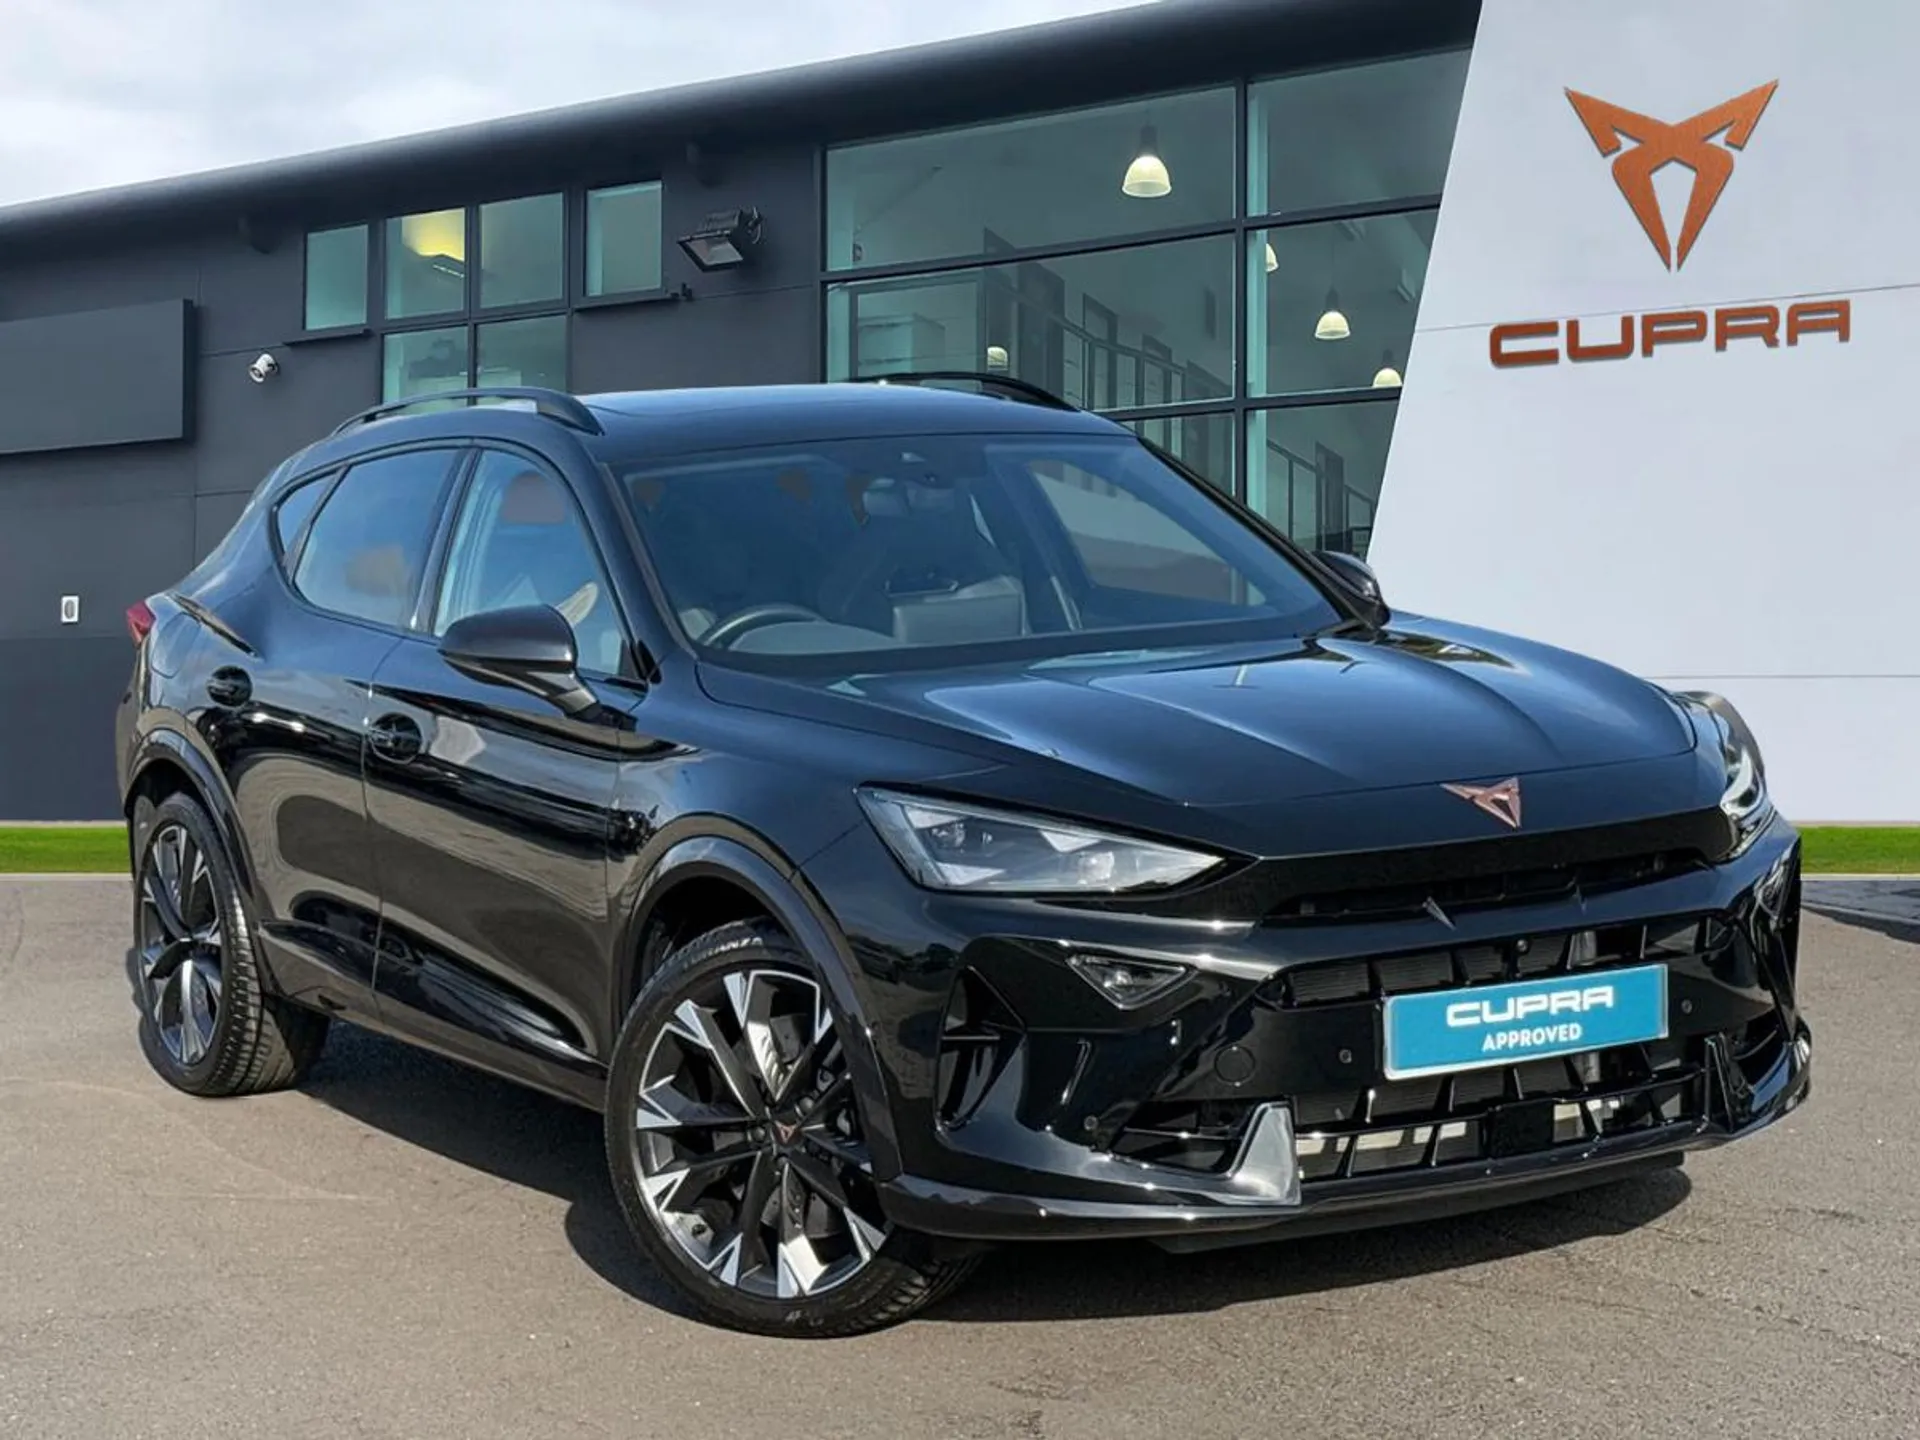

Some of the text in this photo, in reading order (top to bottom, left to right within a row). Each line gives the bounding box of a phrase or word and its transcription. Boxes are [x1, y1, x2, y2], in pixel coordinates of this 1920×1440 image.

[1490, 299, 1850, 368] CUPRA
[1446, 985, 1614, 1027] CUPRA
[1482, 1022, 1584, 1052] APPROVED
